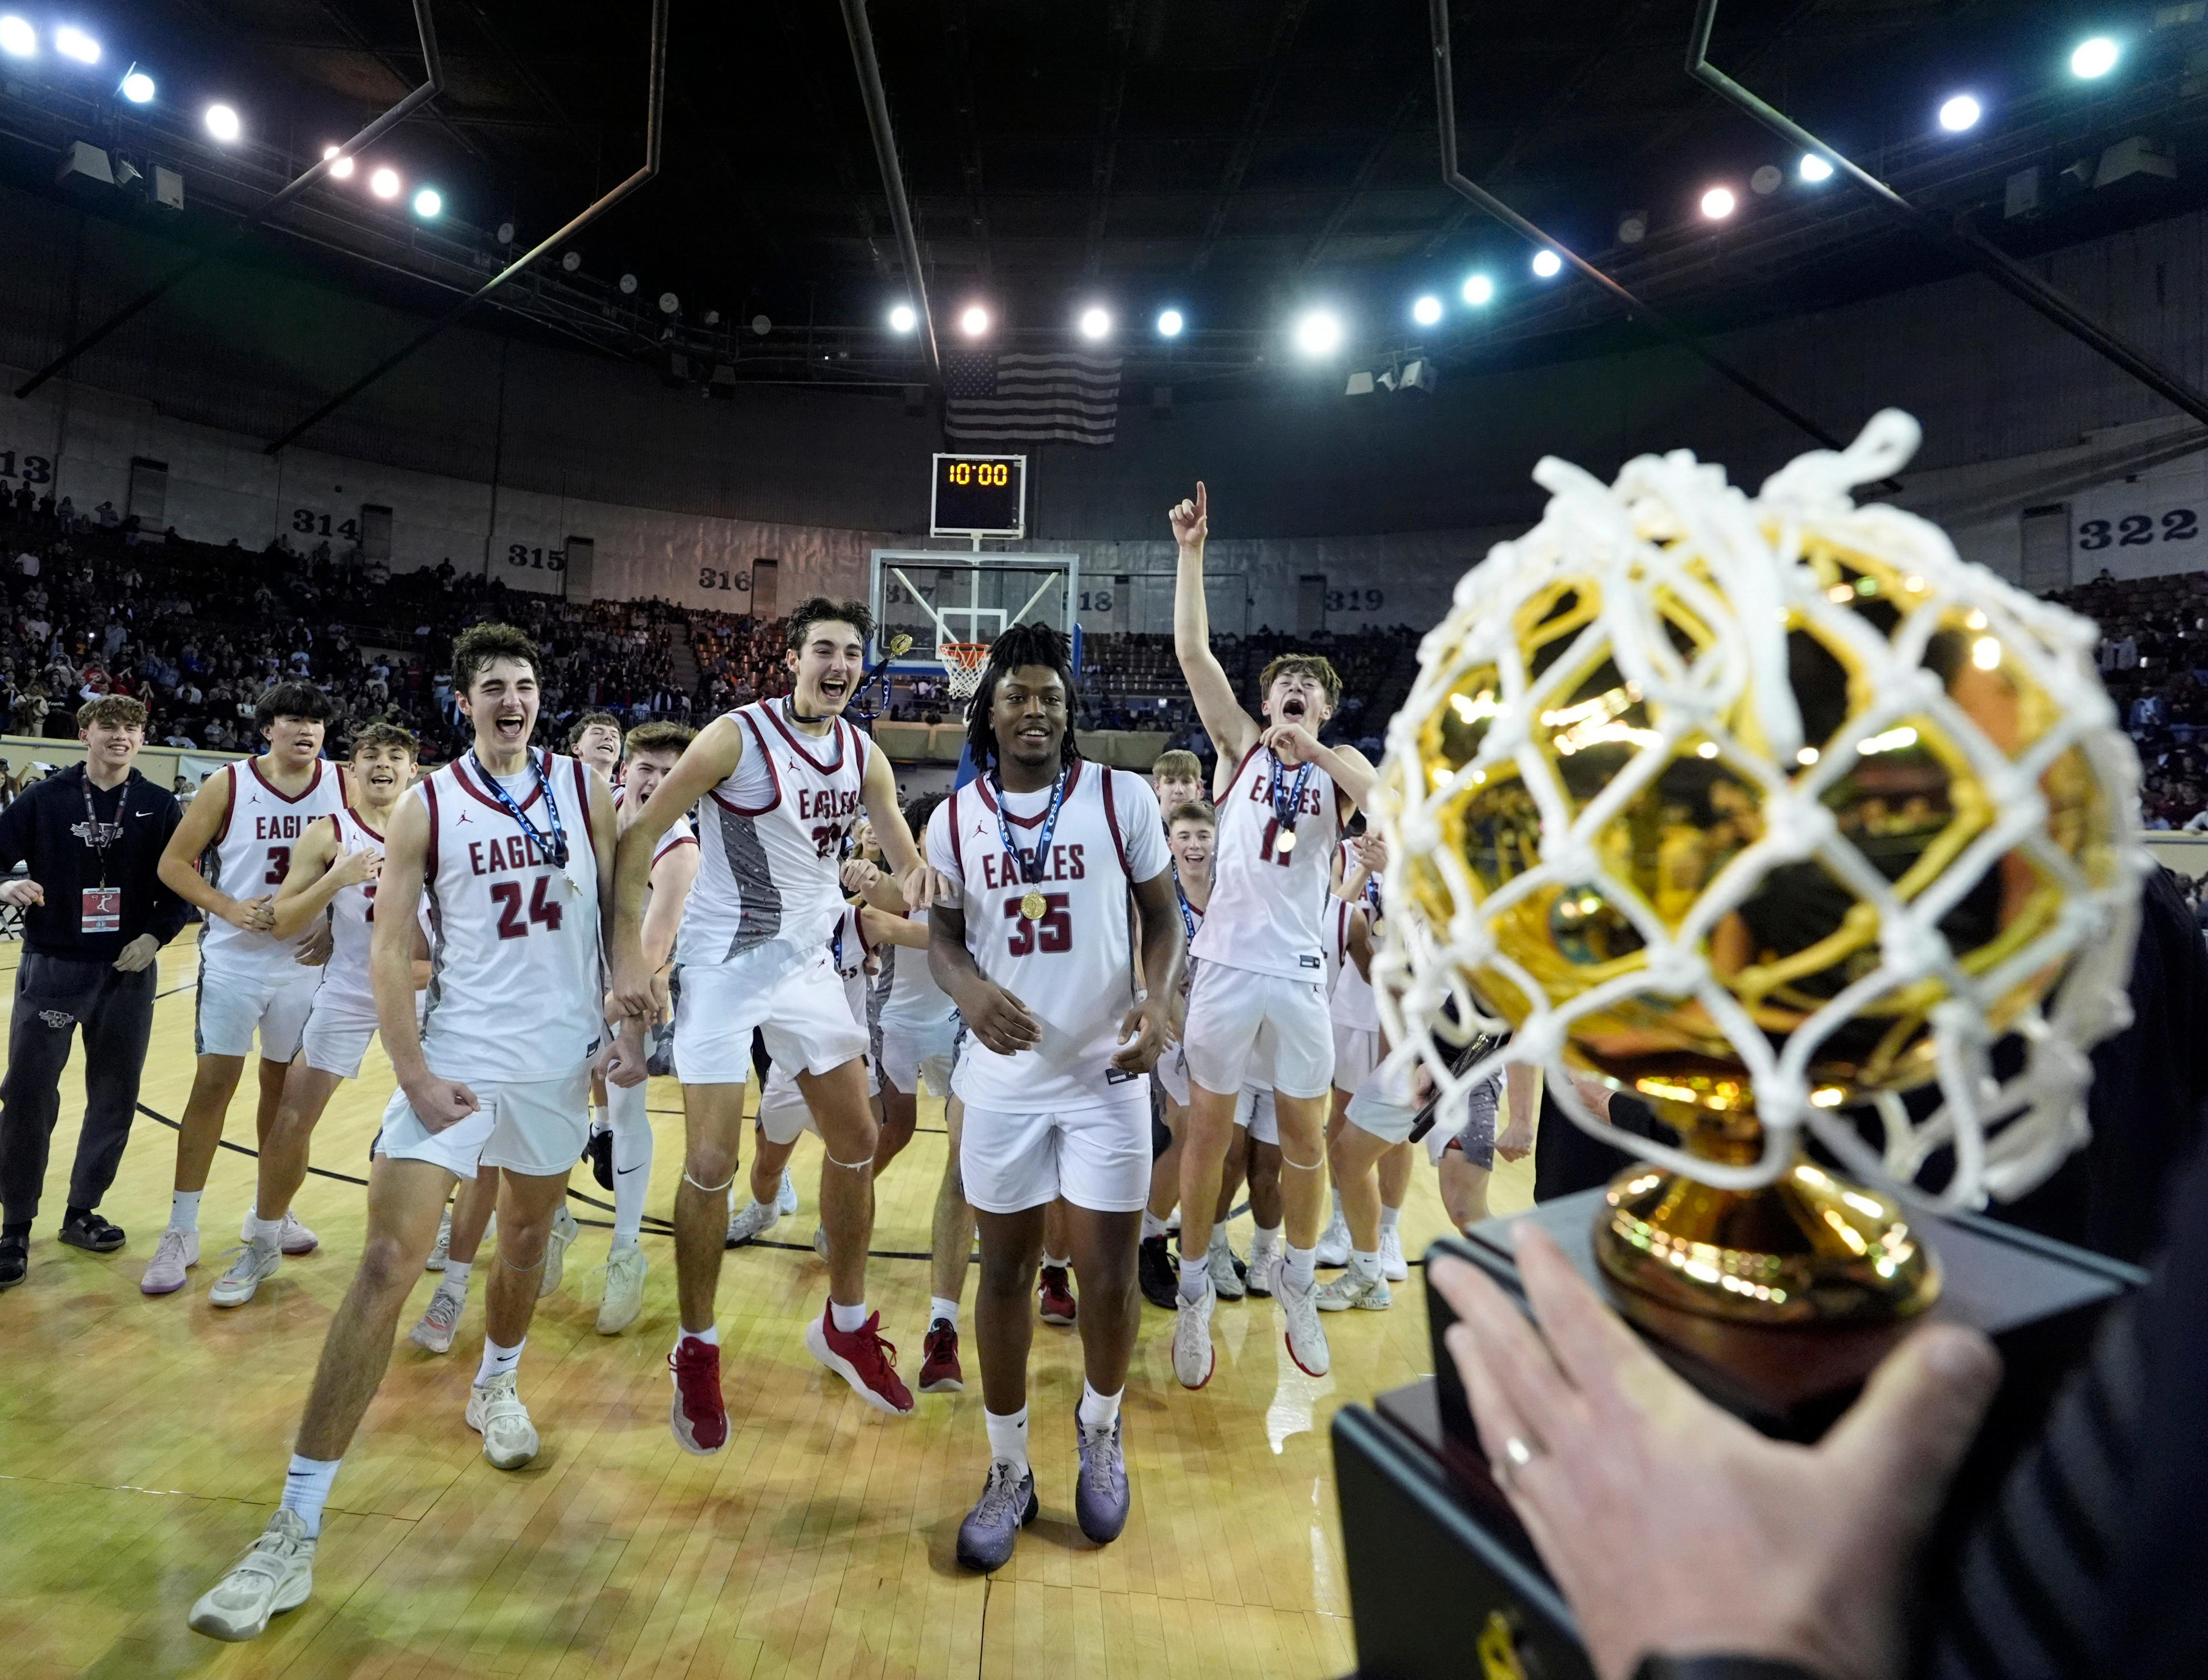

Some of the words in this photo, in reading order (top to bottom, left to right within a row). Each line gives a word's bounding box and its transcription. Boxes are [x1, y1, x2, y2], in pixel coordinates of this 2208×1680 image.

[292, 509, 359, 541] 314
[2079, 509, 2199, 550] 322
[509, 544, 566, 571] 315
[699, 567, 752, 592] 316
[1324, 589, 1385, 612] 319
[798, 788, 857, 820] EAGLES
[1048, 772, 1066, 827] OSSAA
[1249, 774, 1320, 816] EAGES
[256, 815, 326, 839] EAGL
[997, 809, 1019, 864] OSSA
[982, 843, 1085, 889] EAGES
[489, 875, 562, 940] 24
[1003, 892, 1073, 957] 35
